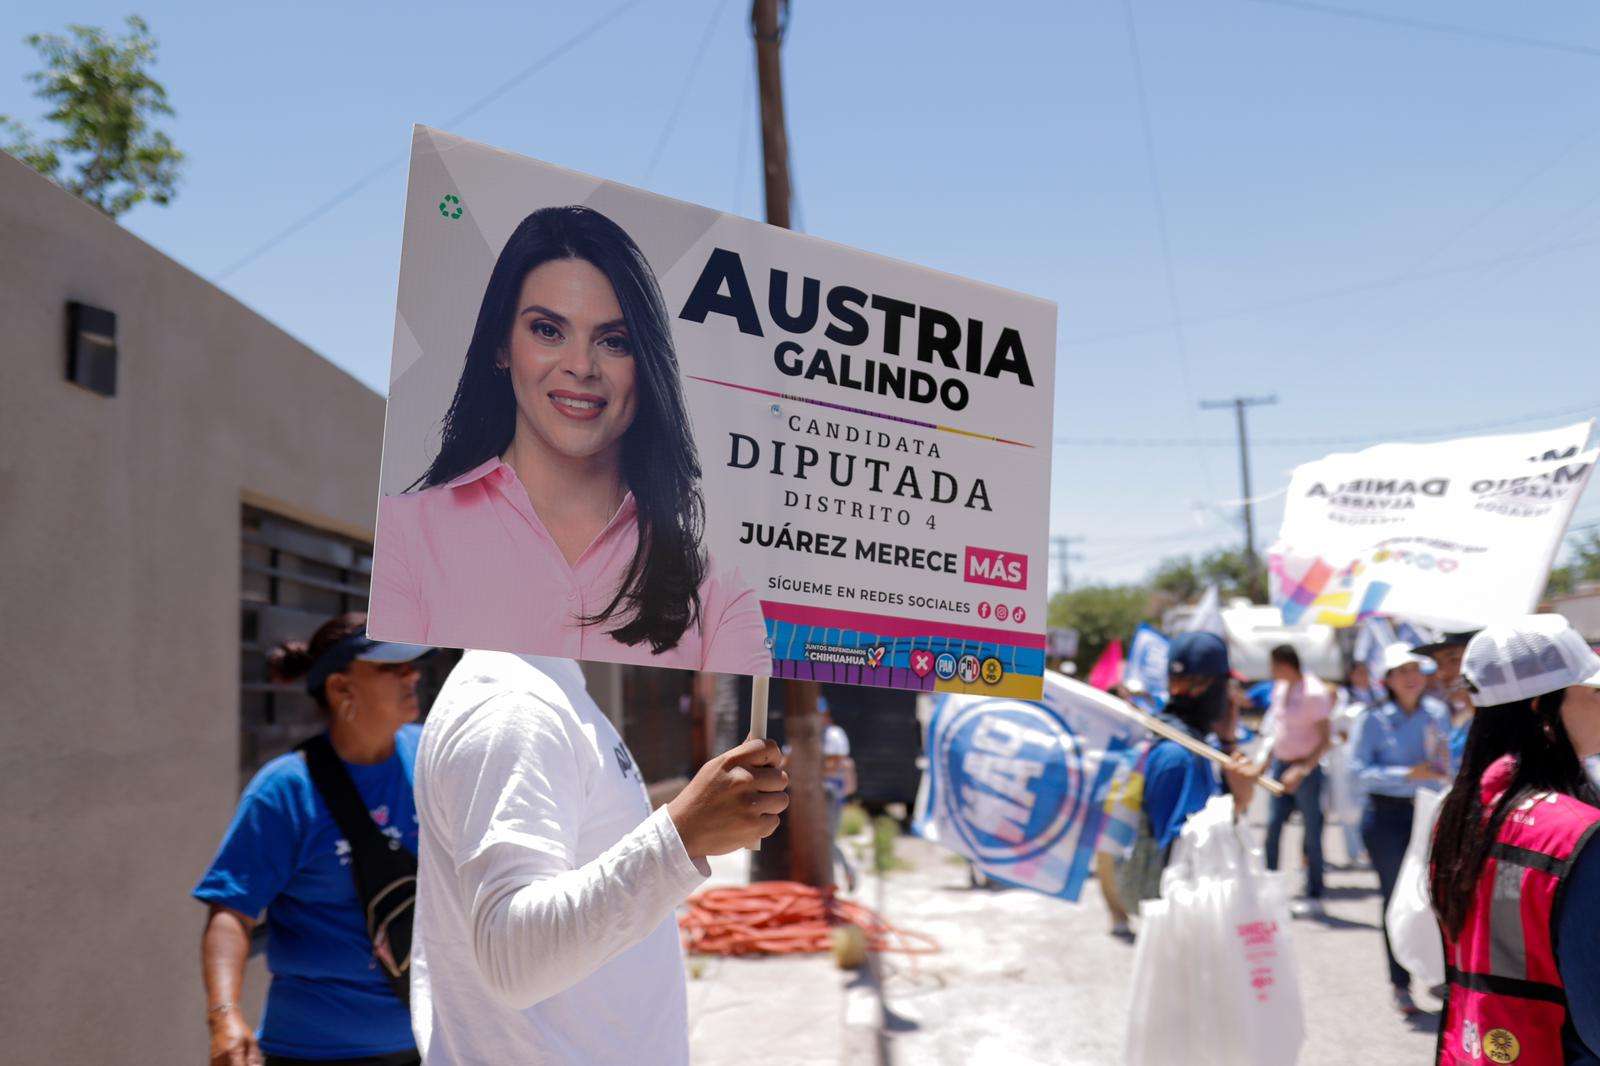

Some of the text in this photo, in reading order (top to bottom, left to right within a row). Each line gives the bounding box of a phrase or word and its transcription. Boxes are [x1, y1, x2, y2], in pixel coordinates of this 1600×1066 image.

[678, 247, 1035, 387] AUSTRIA
[773, 340, 970, 411] GALINDO
[788, 415, 941, 458] CANDIDATA
[727, 432, 993, 511] DIPUTADA
[784, 490, 937, 530] DISTRITO 4
[739, 521, 1022, 583] JUÁREZ MERECE MÁS
[768, 575, 971, 614] SÍGUEME EN REDES SOCIALES
[805, 643, 828, 652] JUNTOS
[810, 652, 866, 665] CHIHUAHUA
